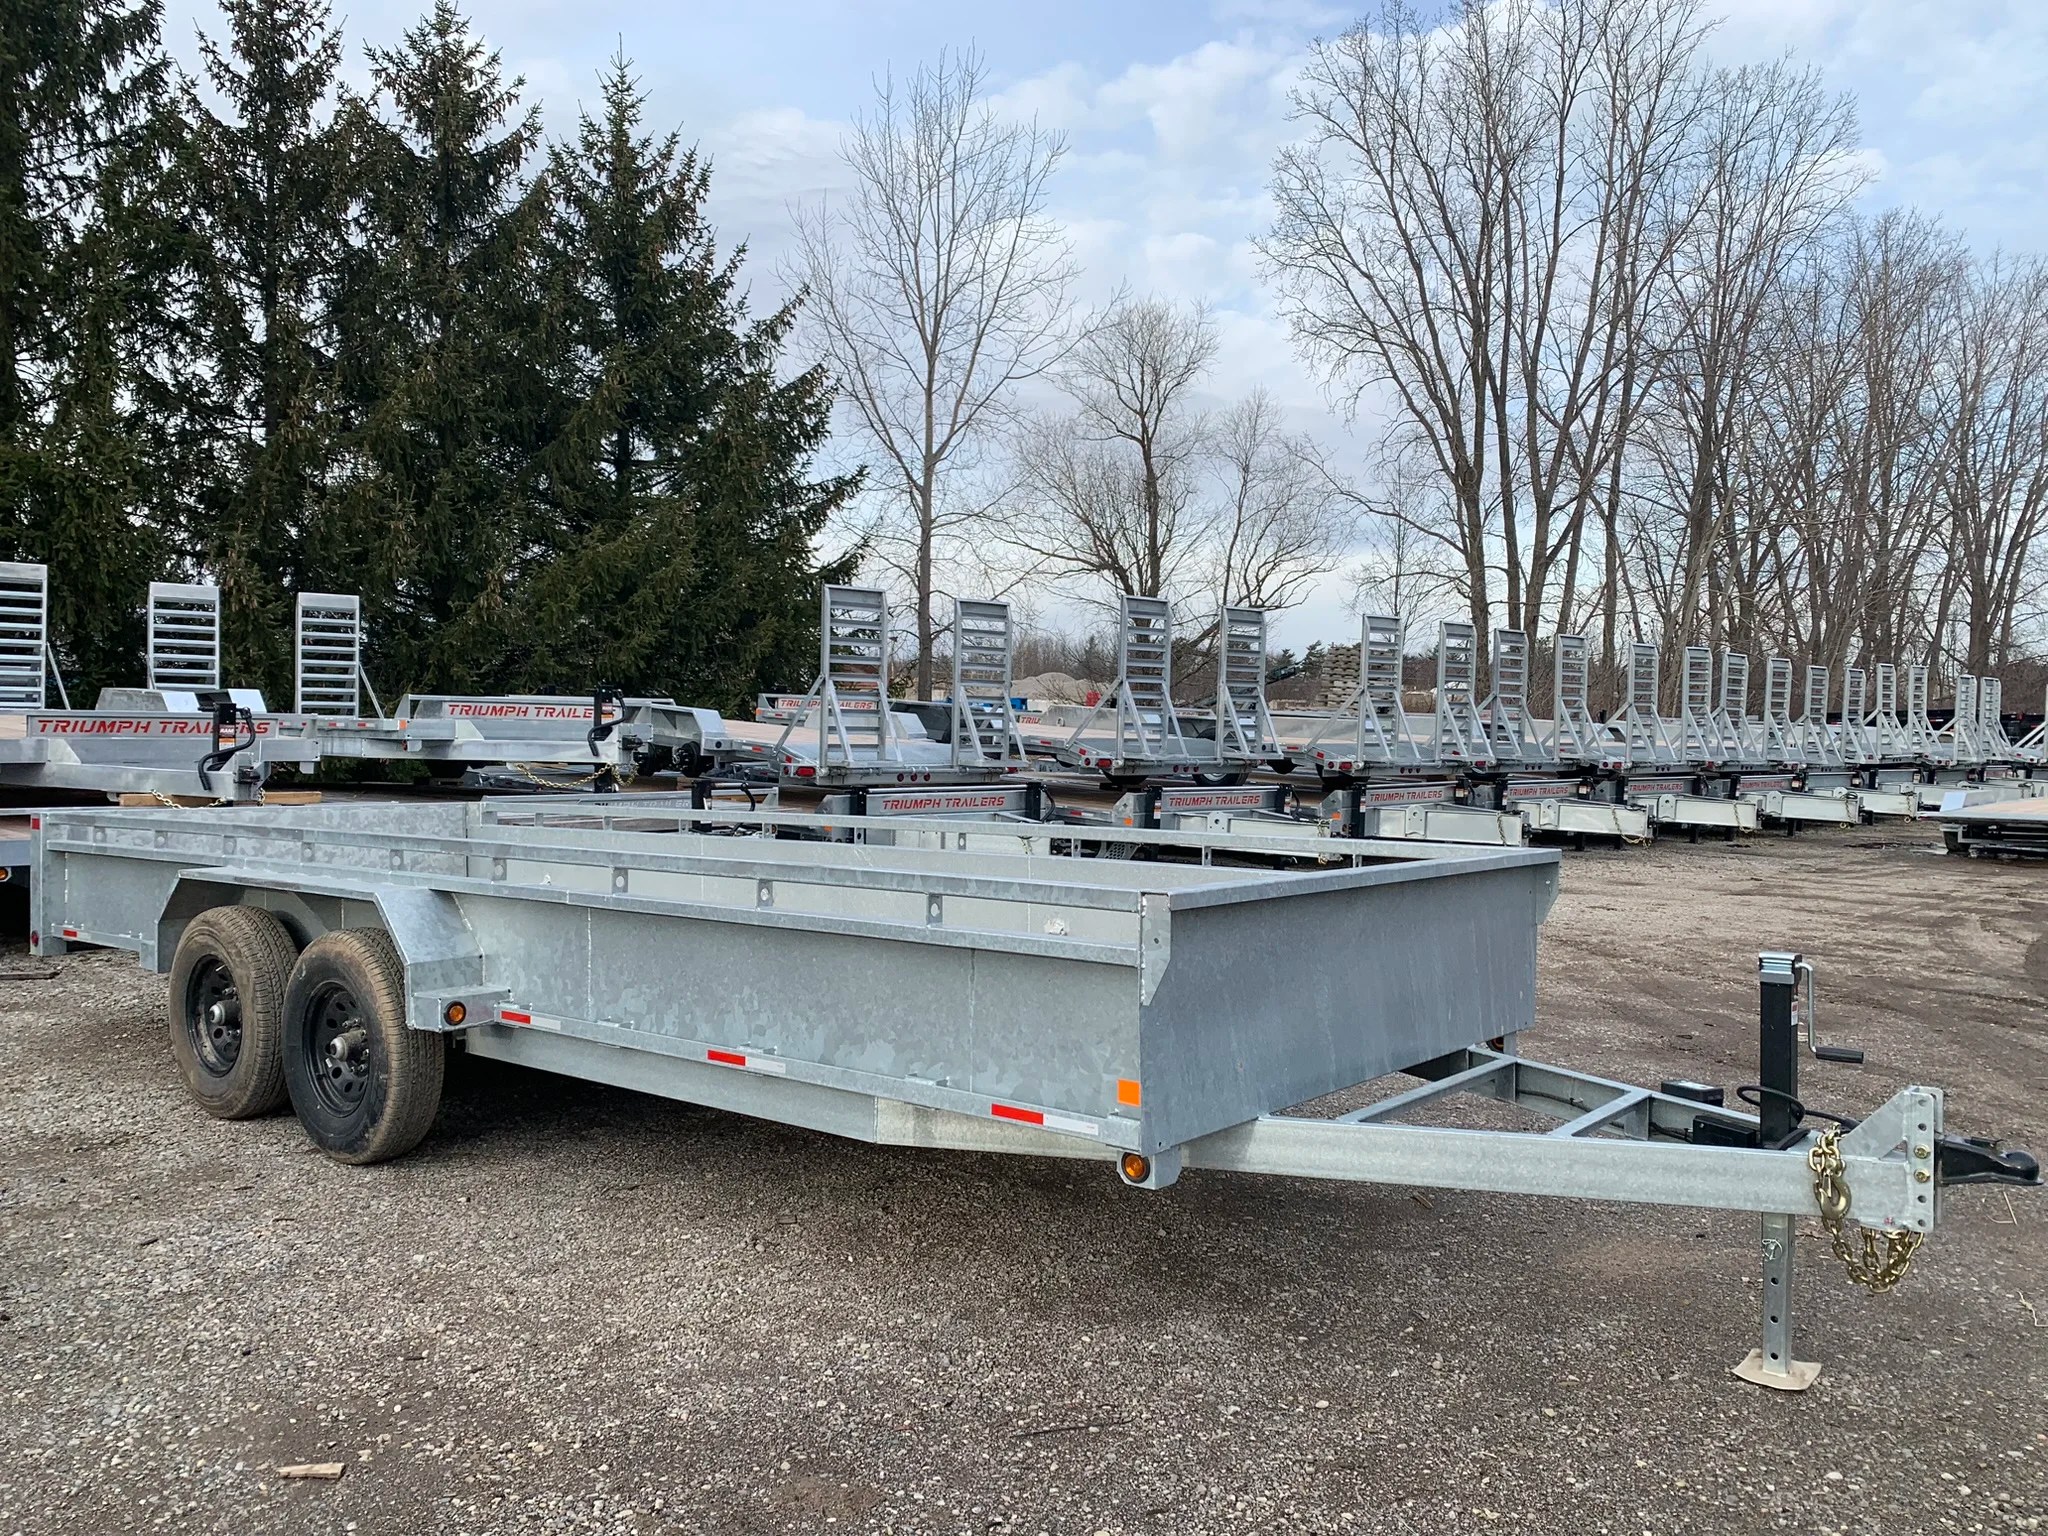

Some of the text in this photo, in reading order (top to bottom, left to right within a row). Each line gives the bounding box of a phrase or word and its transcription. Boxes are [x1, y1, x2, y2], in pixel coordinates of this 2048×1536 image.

[448, 704, 529, 717] TRIUMPH
[534, 707, 615, 719] TRAILE
[1021, 716, 1040, 724] TRIU
[38, 719, 152, 734] TRIUMPH
[1509, 787, 1569, 796] TRIUMPH TRAILERS
[1656, 783, 1683, 791] TRAILERS
[1169, 795, 1261, 807] TRIUMPH TRAILERS
[1370, 790, 1443, 802] TRIUMPH TRAILERS
[882, 796, 1005, 810] TRIUMPH TRAILERS
